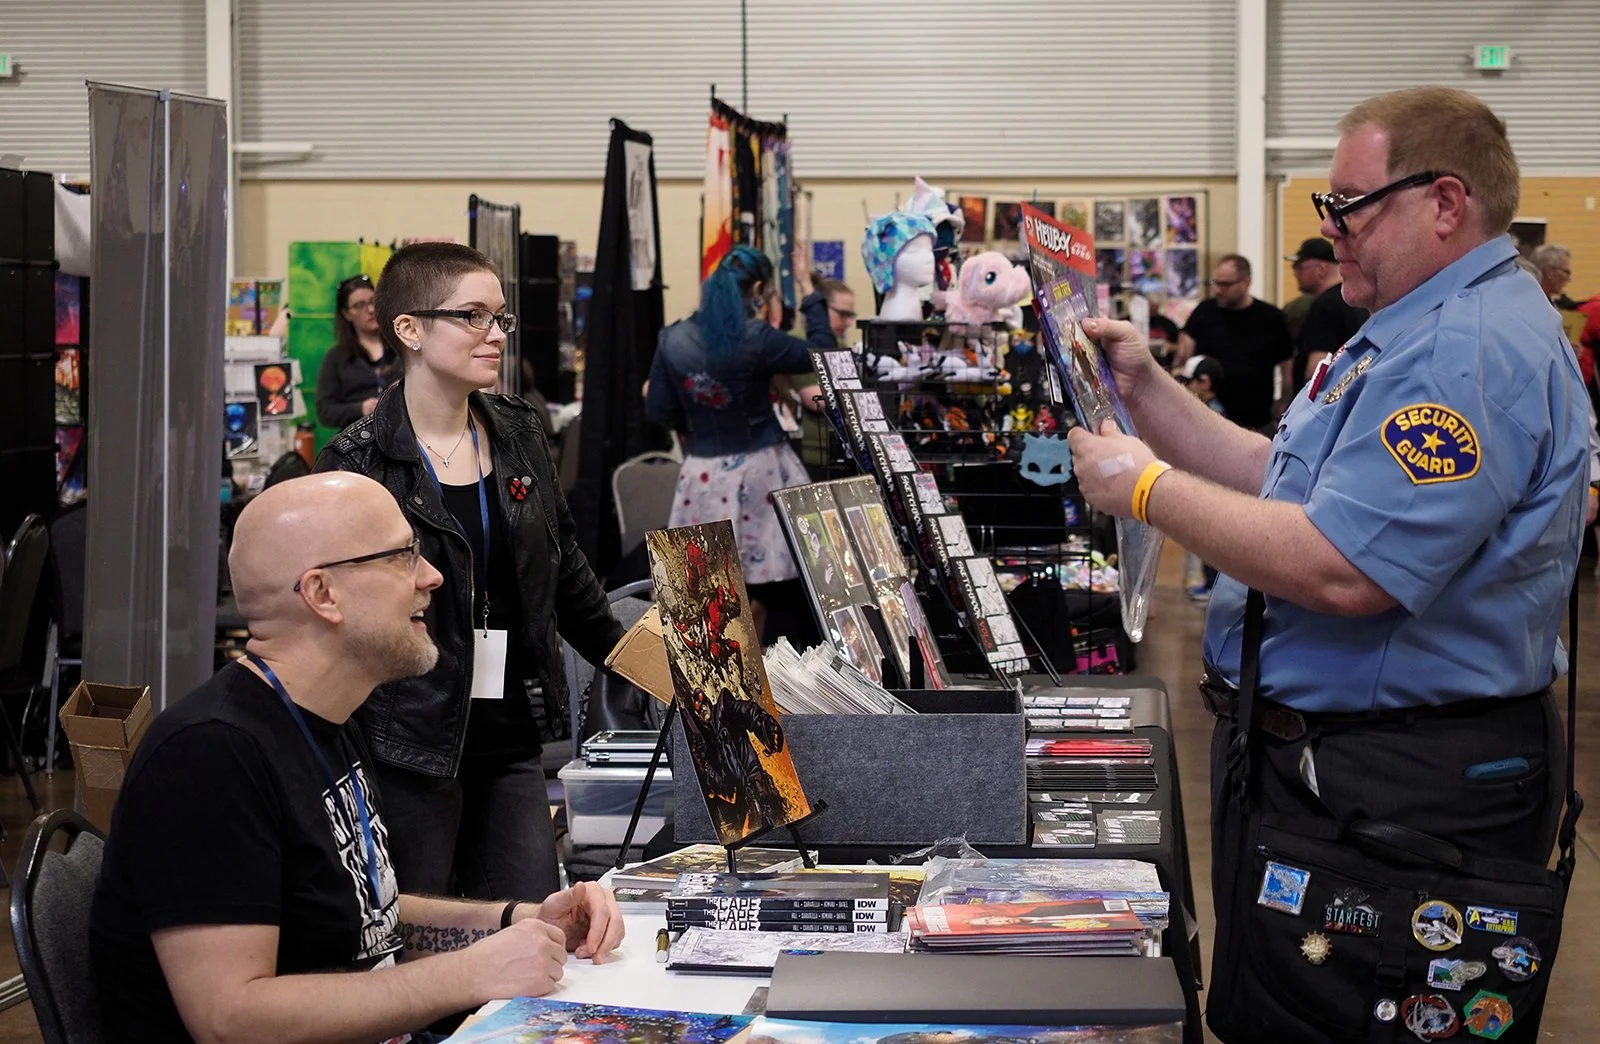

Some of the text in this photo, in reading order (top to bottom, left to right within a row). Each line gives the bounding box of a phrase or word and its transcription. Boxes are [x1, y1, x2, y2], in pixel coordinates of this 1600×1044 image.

[1395, 408, 1476, 455] SECURITY
[1396, 439, 1456, 475] GUARD
[719, 897, 759, 910] CAPE
[717, 909, 757, 921] CAPE
[855, 912, 874, 920] IDW
[1326, 907, 1379, 928] STARFEST
